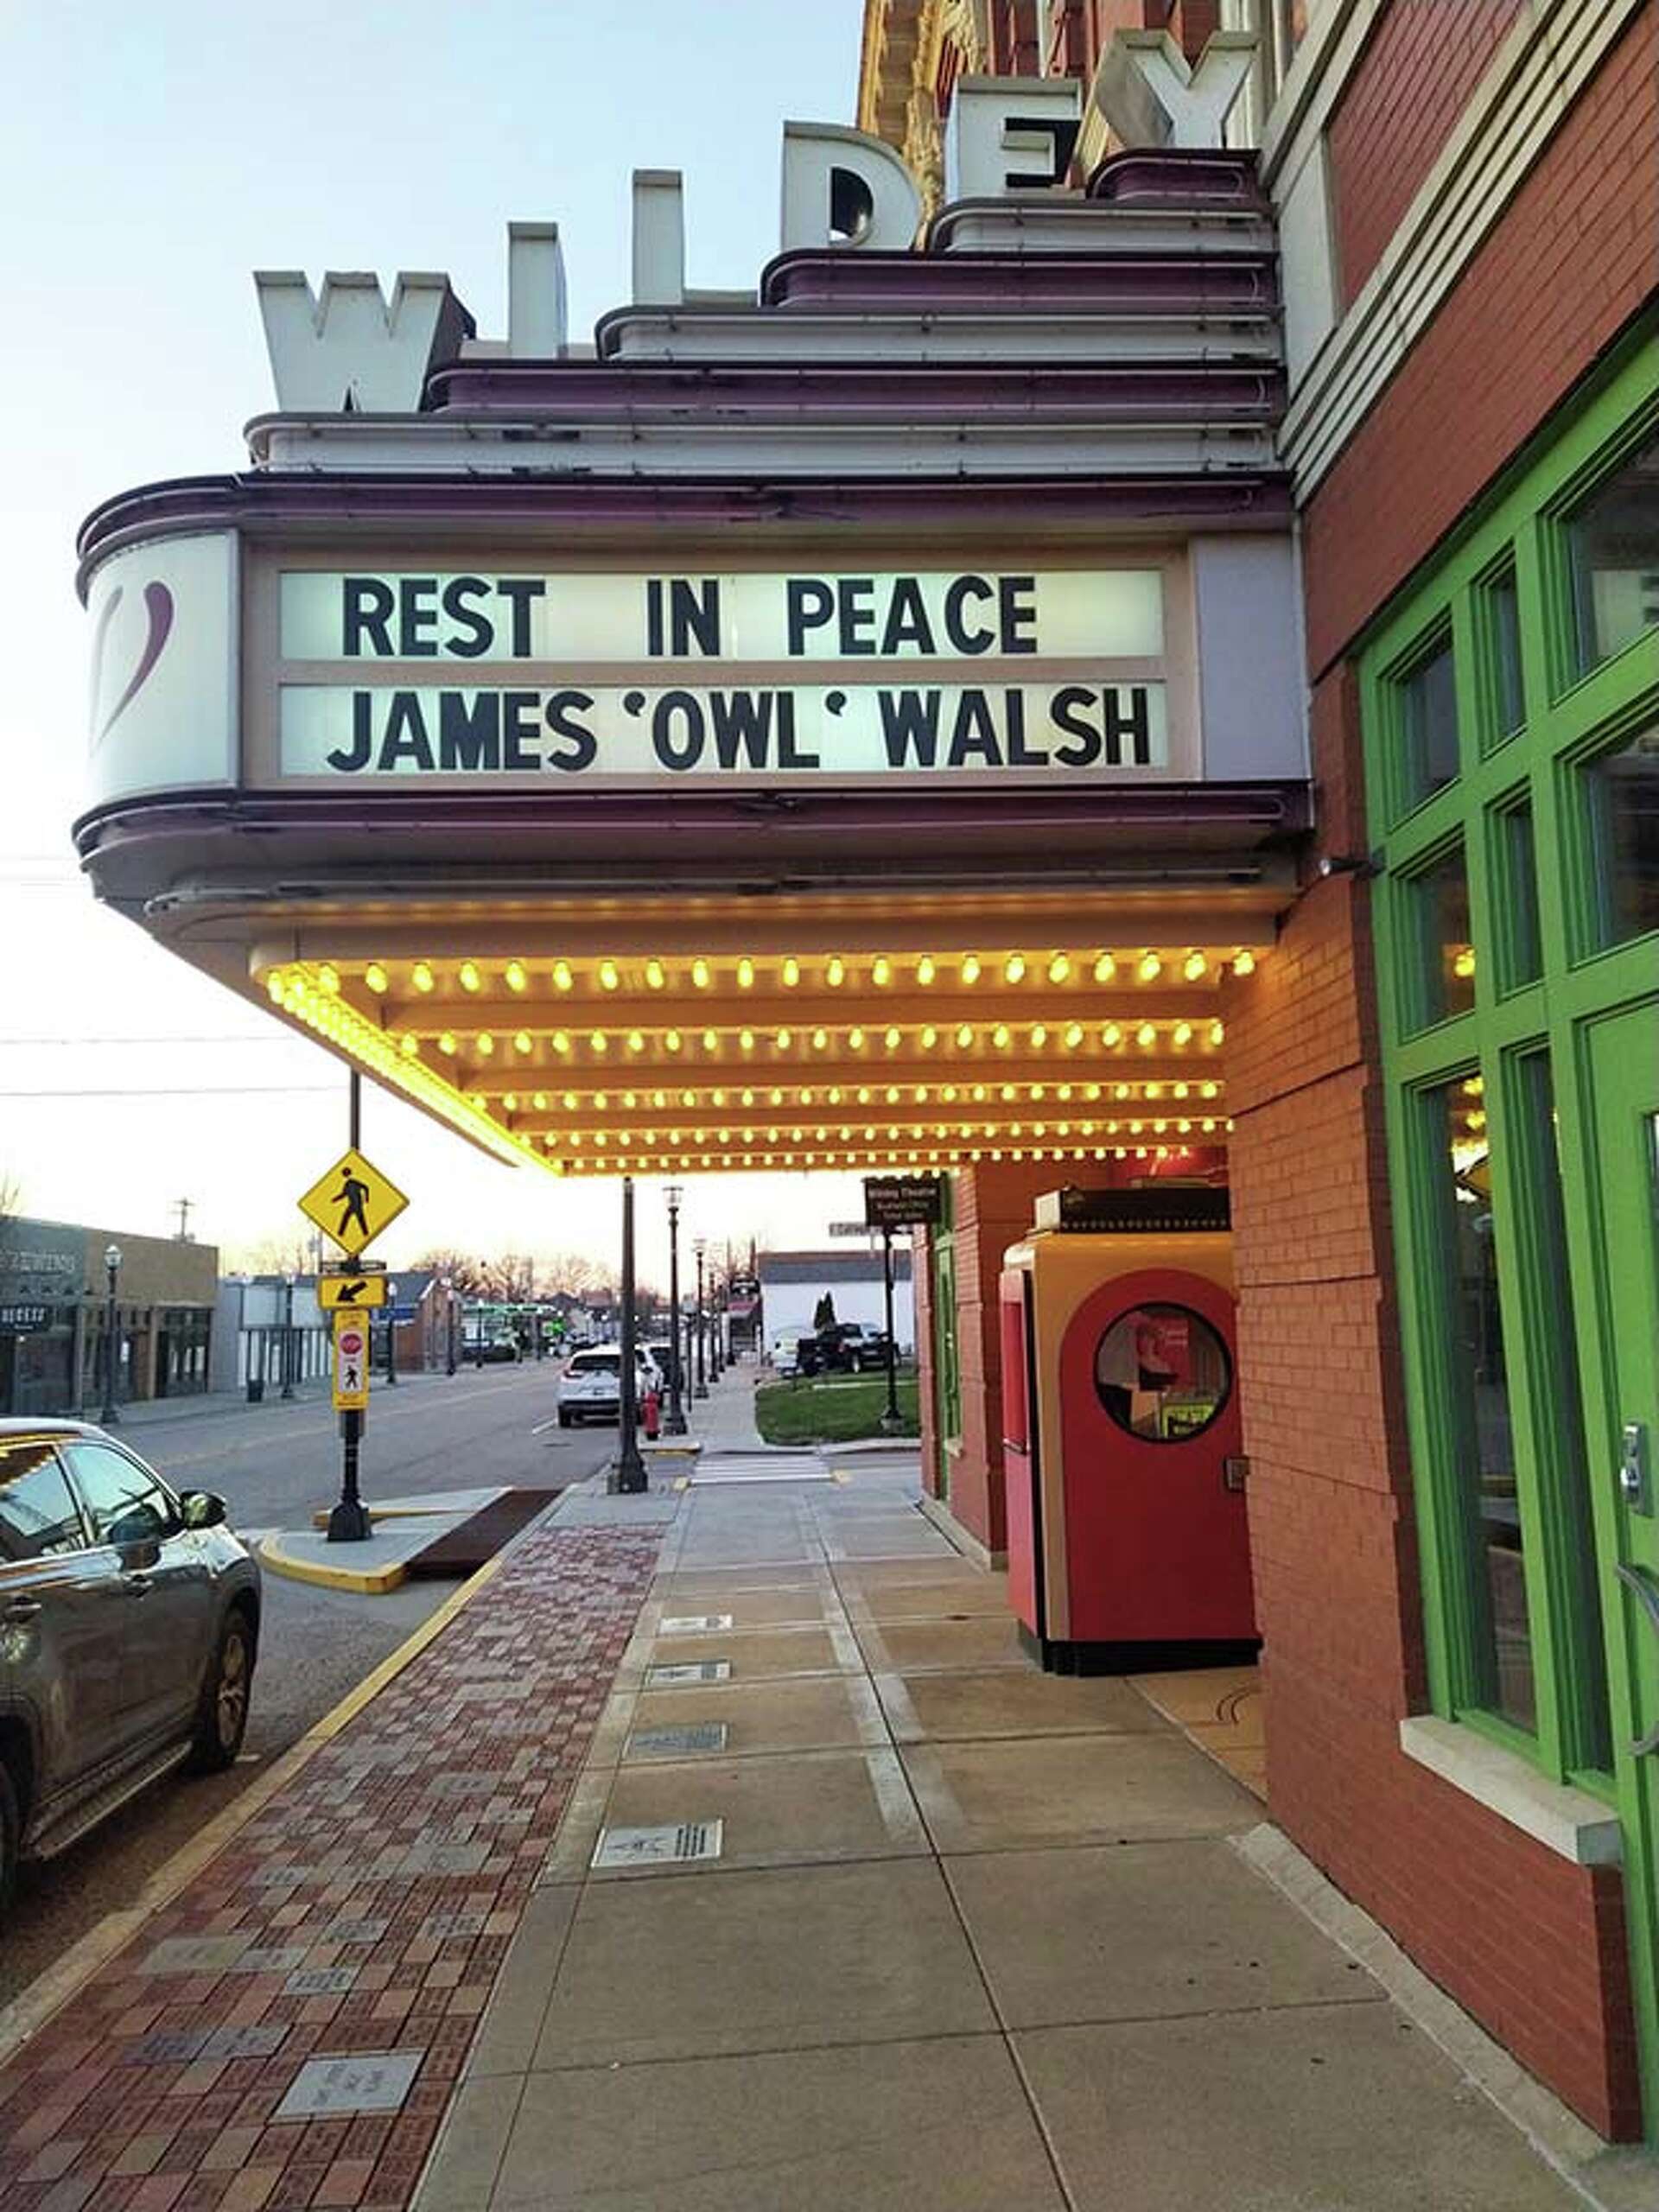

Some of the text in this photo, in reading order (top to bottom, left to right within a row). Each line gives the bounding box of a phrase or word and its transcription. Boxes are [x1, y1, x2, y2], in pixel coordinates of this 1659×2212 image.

[254, 29, 1260, 413] WILDEY
[343, 575, 1038, 658] REST IN PEACE
[327, 690, 599, 772] JAMES
[878, 687, 1151, 767] WALSH
